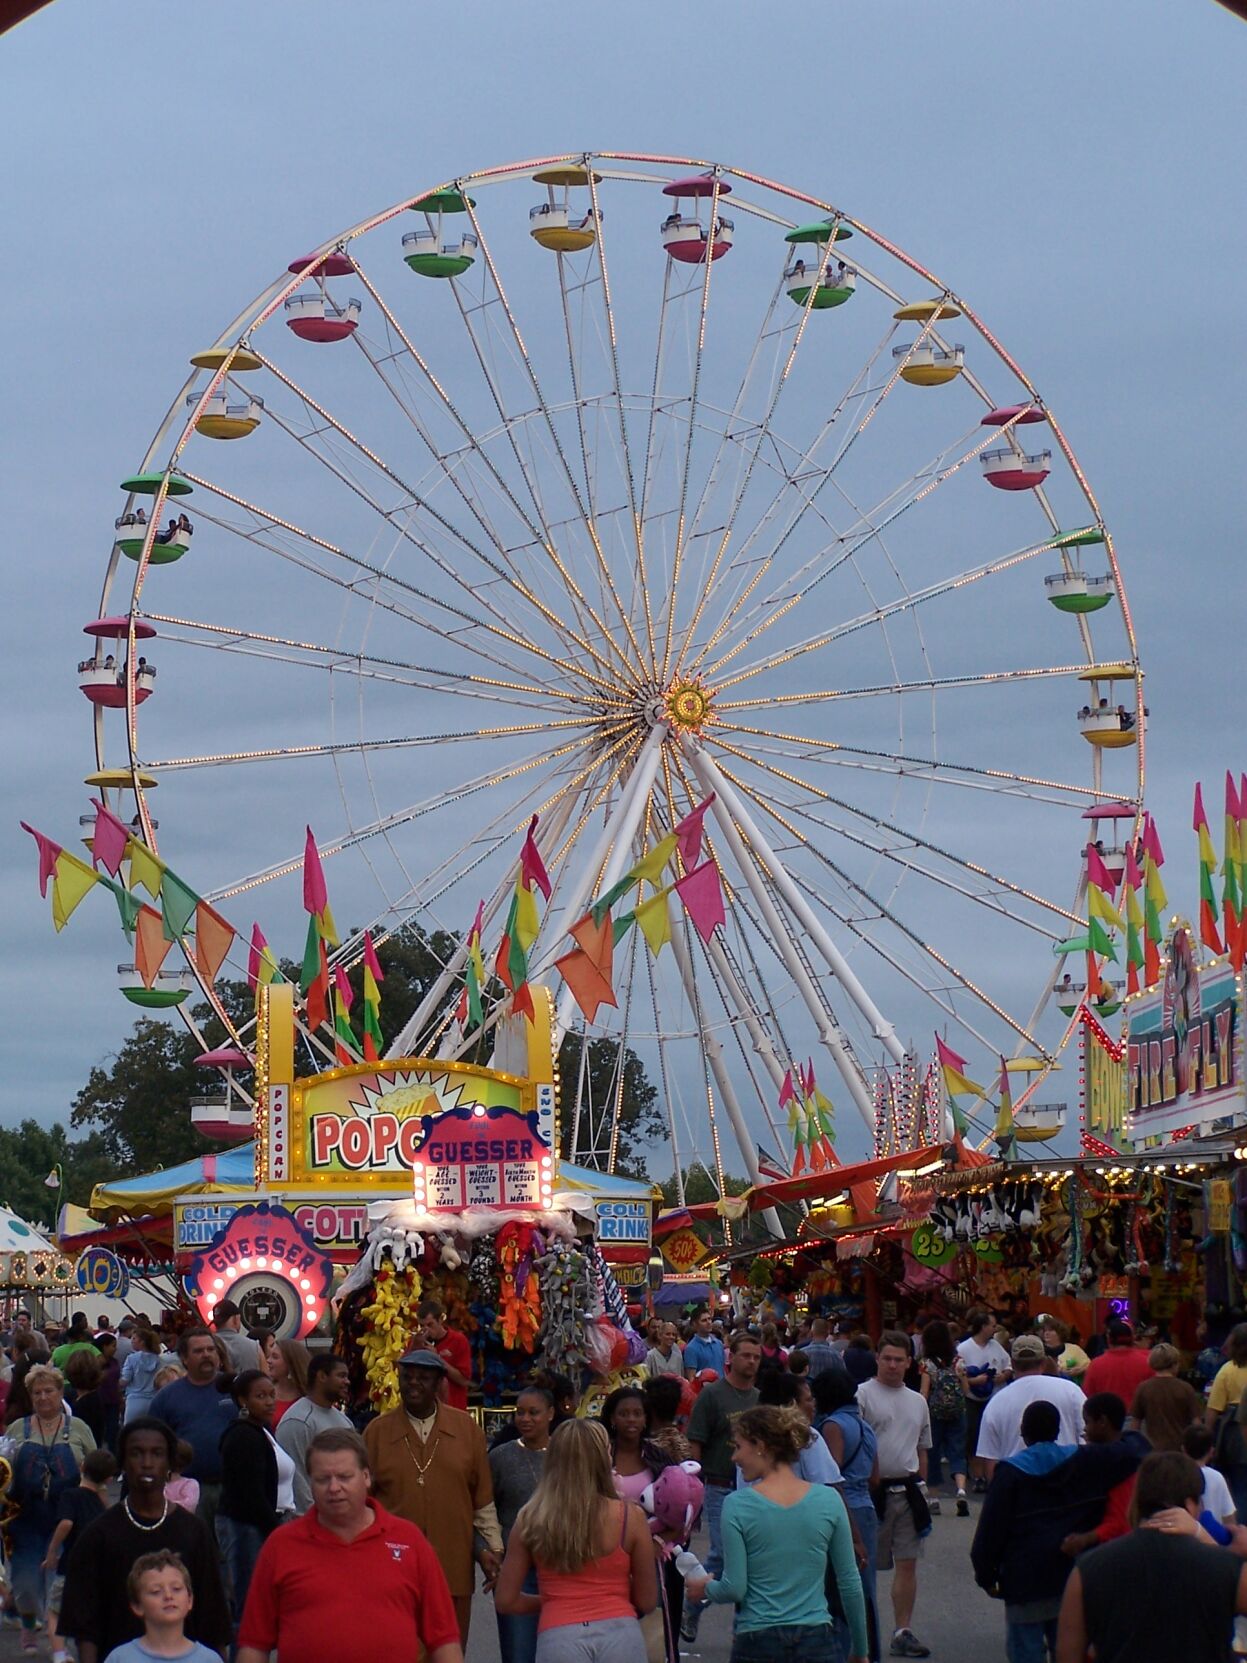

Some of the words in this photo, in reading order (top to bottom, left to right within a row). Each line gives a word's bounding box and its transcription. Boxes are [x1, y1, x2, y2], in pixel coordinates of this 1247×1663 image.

[1128, 1035, 1176, 1113] FIRE
[1187, 1006, 1231, 1095] FLY
[540, 1088, 552, 1117] SNO
[273, 1089, 284, 1180] POPCORN
[312, 1113, 424, 1168] POPC
[428, 1139, 534, 1163] GUESSER
[469, 1169, 494, 1177] WEIGHT
[470, 1196, 495, 1204] POUNDS
[510, 1194, 533, 1203] MONTH
[517, 1188, 523, 1196] 2
[183, 1206, 238, 1220] COLD
[596, 1202, 646, 1217] COLD
[294, 1205, 368, 1240] COTT
[600, 1217, 649, 1240] RINK
[207, 1235, 316, 1274] GUESSER
